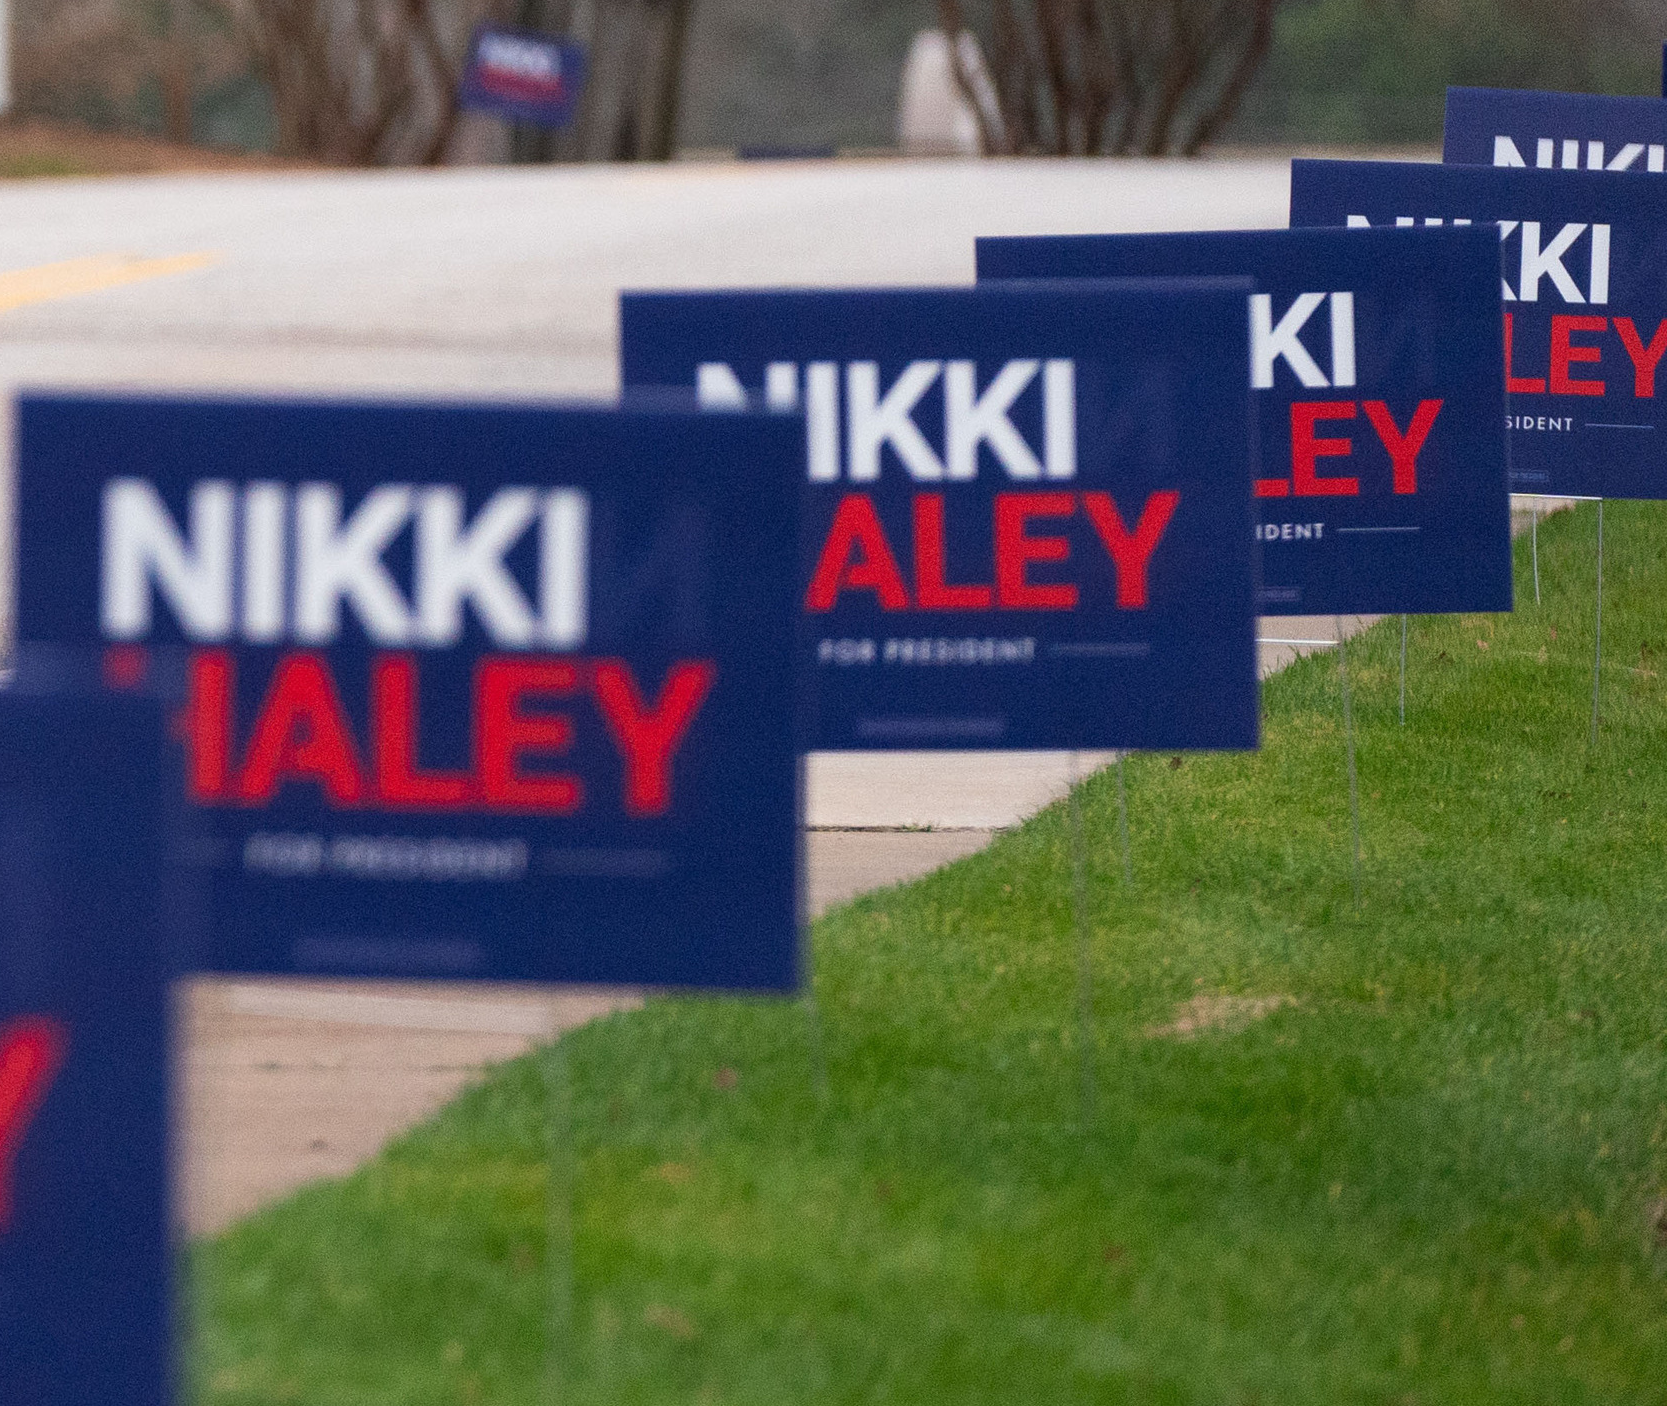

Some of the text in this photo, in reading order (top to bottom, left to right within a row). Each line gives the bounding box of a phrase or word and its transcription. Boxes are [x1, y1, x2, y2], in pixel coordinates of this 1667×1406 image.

[1503, 312, 1667, 398] LEY
[1504, 416, 1573, 432] SIDENT
[99, 477, 589, 650] NIKKI
[804, 490, 1180, 611] ALEY
[1255, 523, 1325, 540] IDENT
